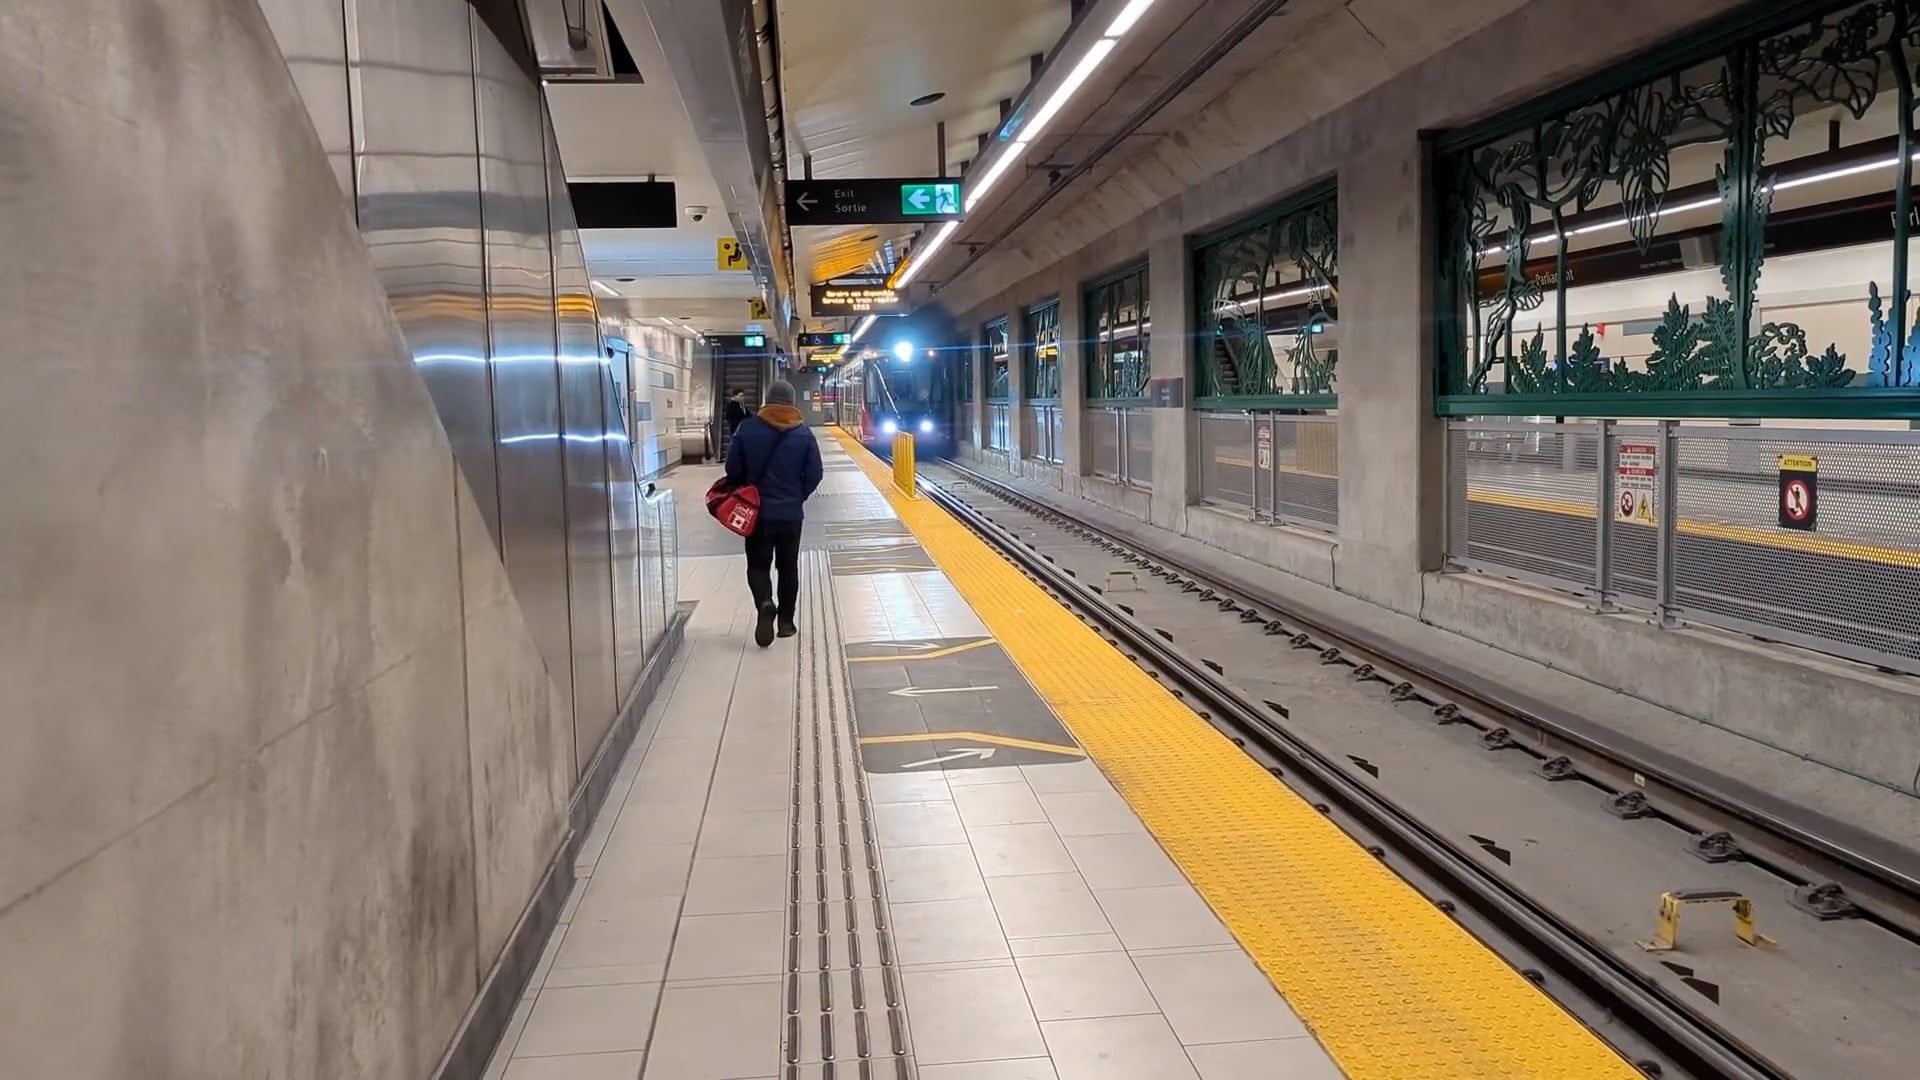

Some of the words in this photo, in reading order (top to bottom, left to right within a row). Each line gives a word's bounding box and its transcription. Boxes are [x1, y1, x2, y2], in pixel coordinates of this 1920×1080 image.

[834, 189, 854, 199] Exit
[834, 203, 867, 213] Sortie
[1534, 268, 1574, 287] Parliant
[1784, 459, 1812, 468] ATTENTION
